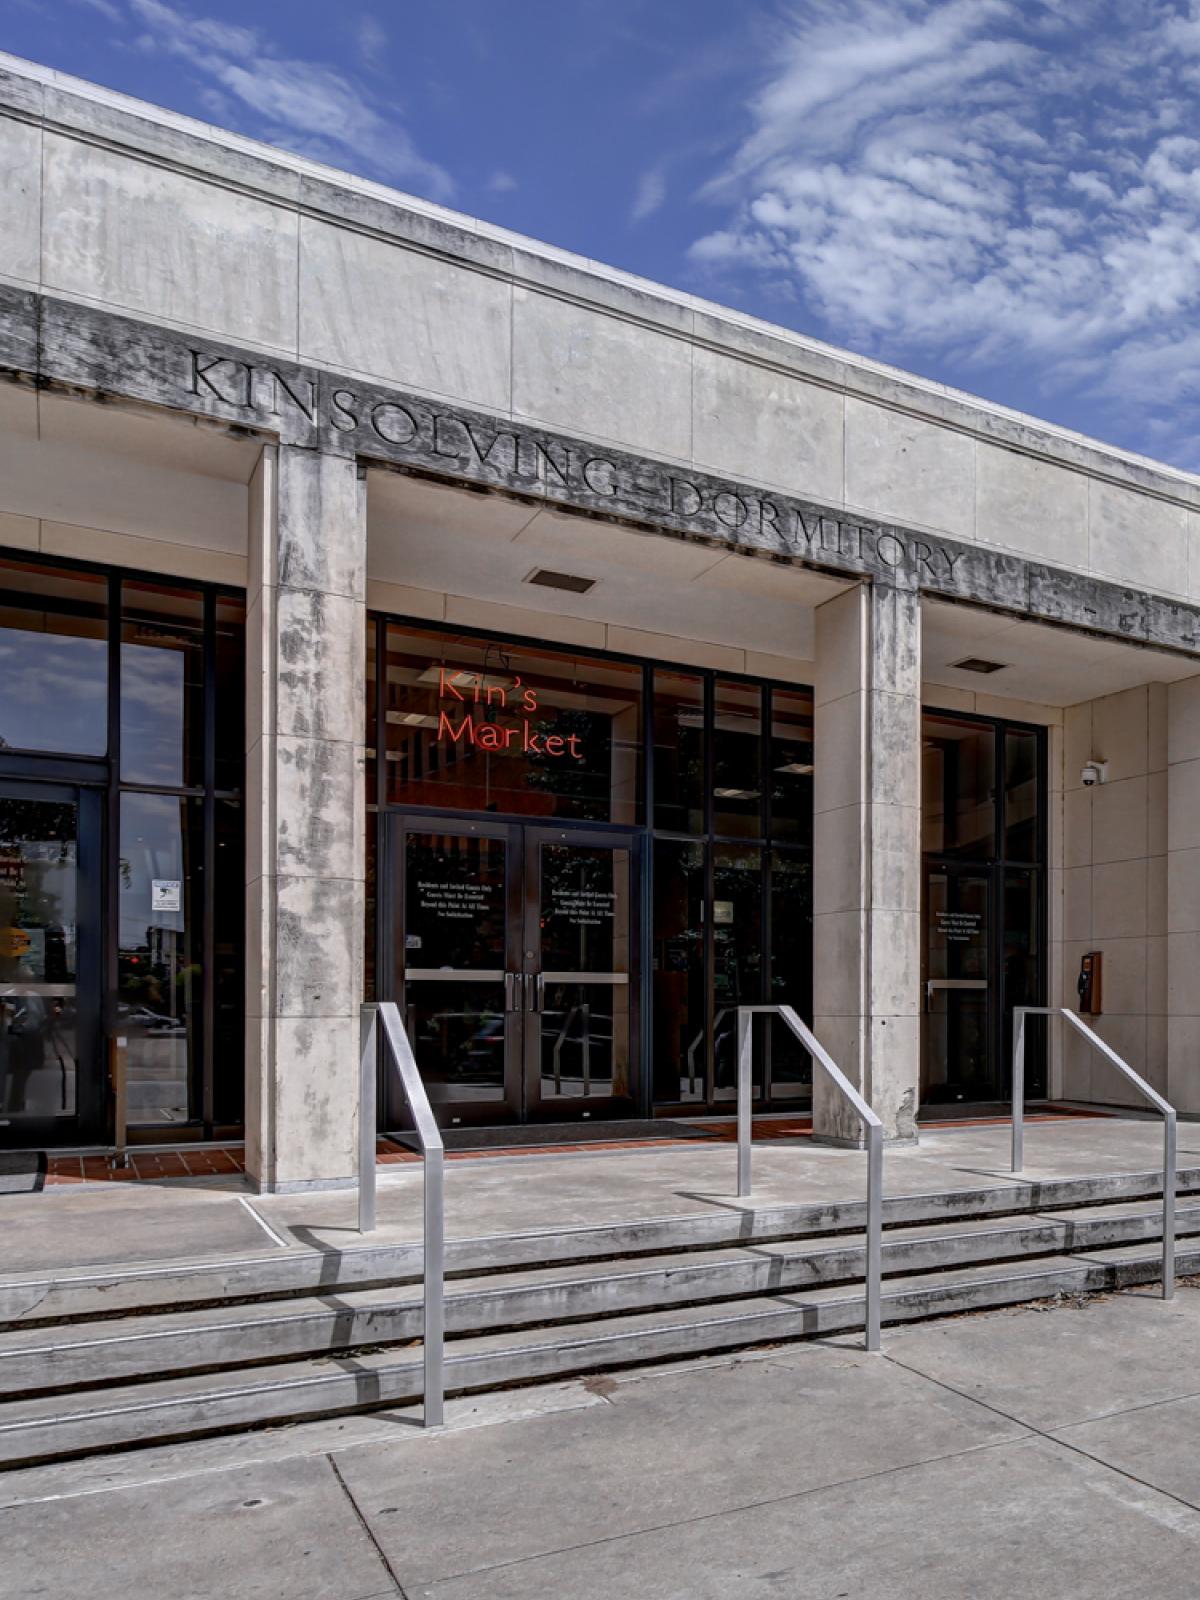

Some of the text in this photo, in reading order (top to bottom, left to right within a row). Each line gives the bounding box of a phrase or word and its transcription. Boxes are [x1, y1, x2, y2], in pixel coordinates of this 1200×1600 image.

[187, 349, 964, 582] KINSOLVING DORMITORY
[437, 666, 538, 712] Kin's
[437, 709, 583, 759] Market
